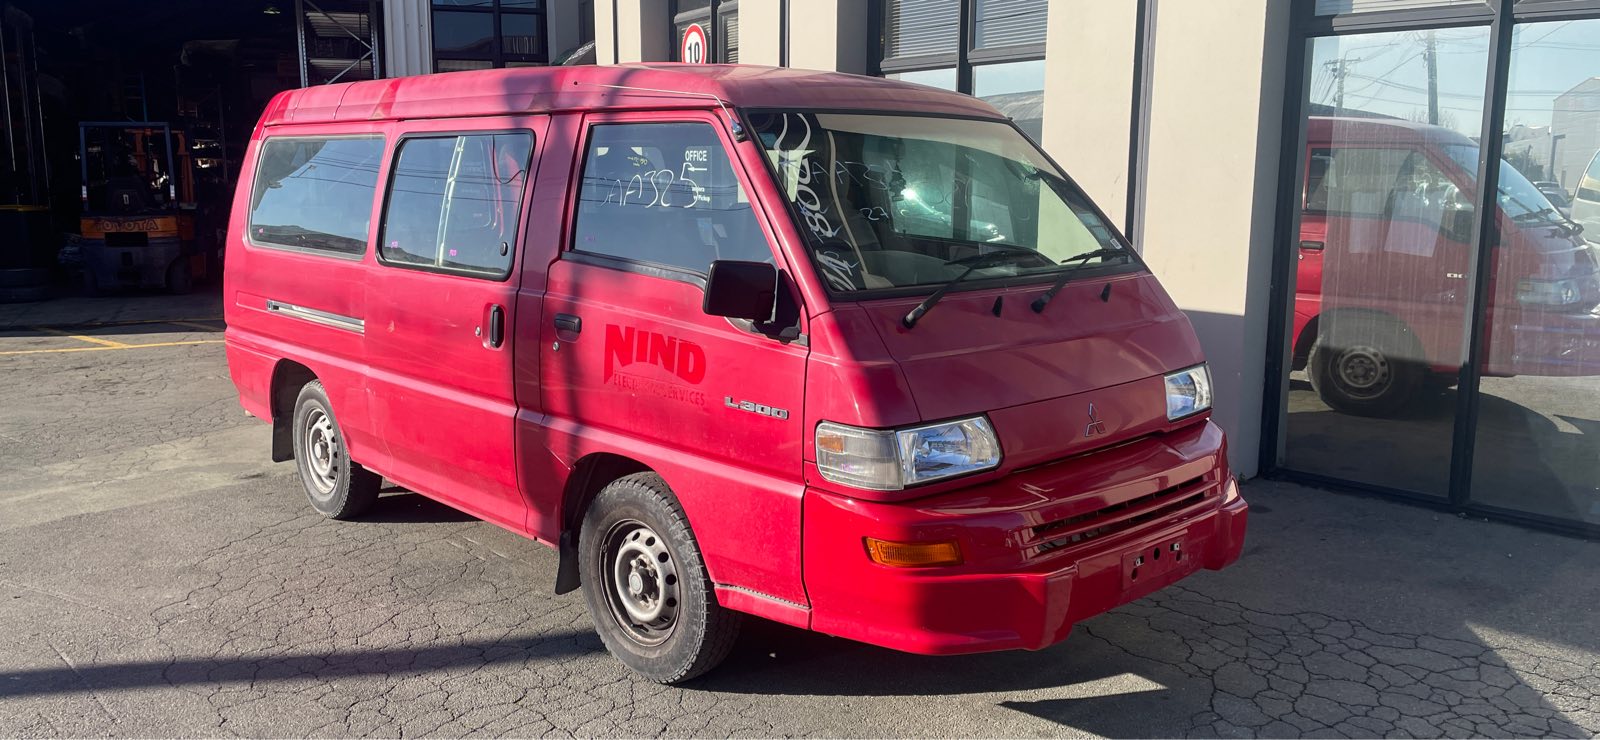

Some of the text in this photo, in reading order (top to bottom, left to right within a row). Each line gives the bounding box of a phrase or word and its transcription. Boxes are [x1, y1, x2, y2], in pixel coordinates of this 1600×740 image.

[687, 42, 700, 63] 10
[685, 150, 708, 161] OFFICE
[604, 324, 706, 385] NIND
[724, 396, 790, 421] L300
